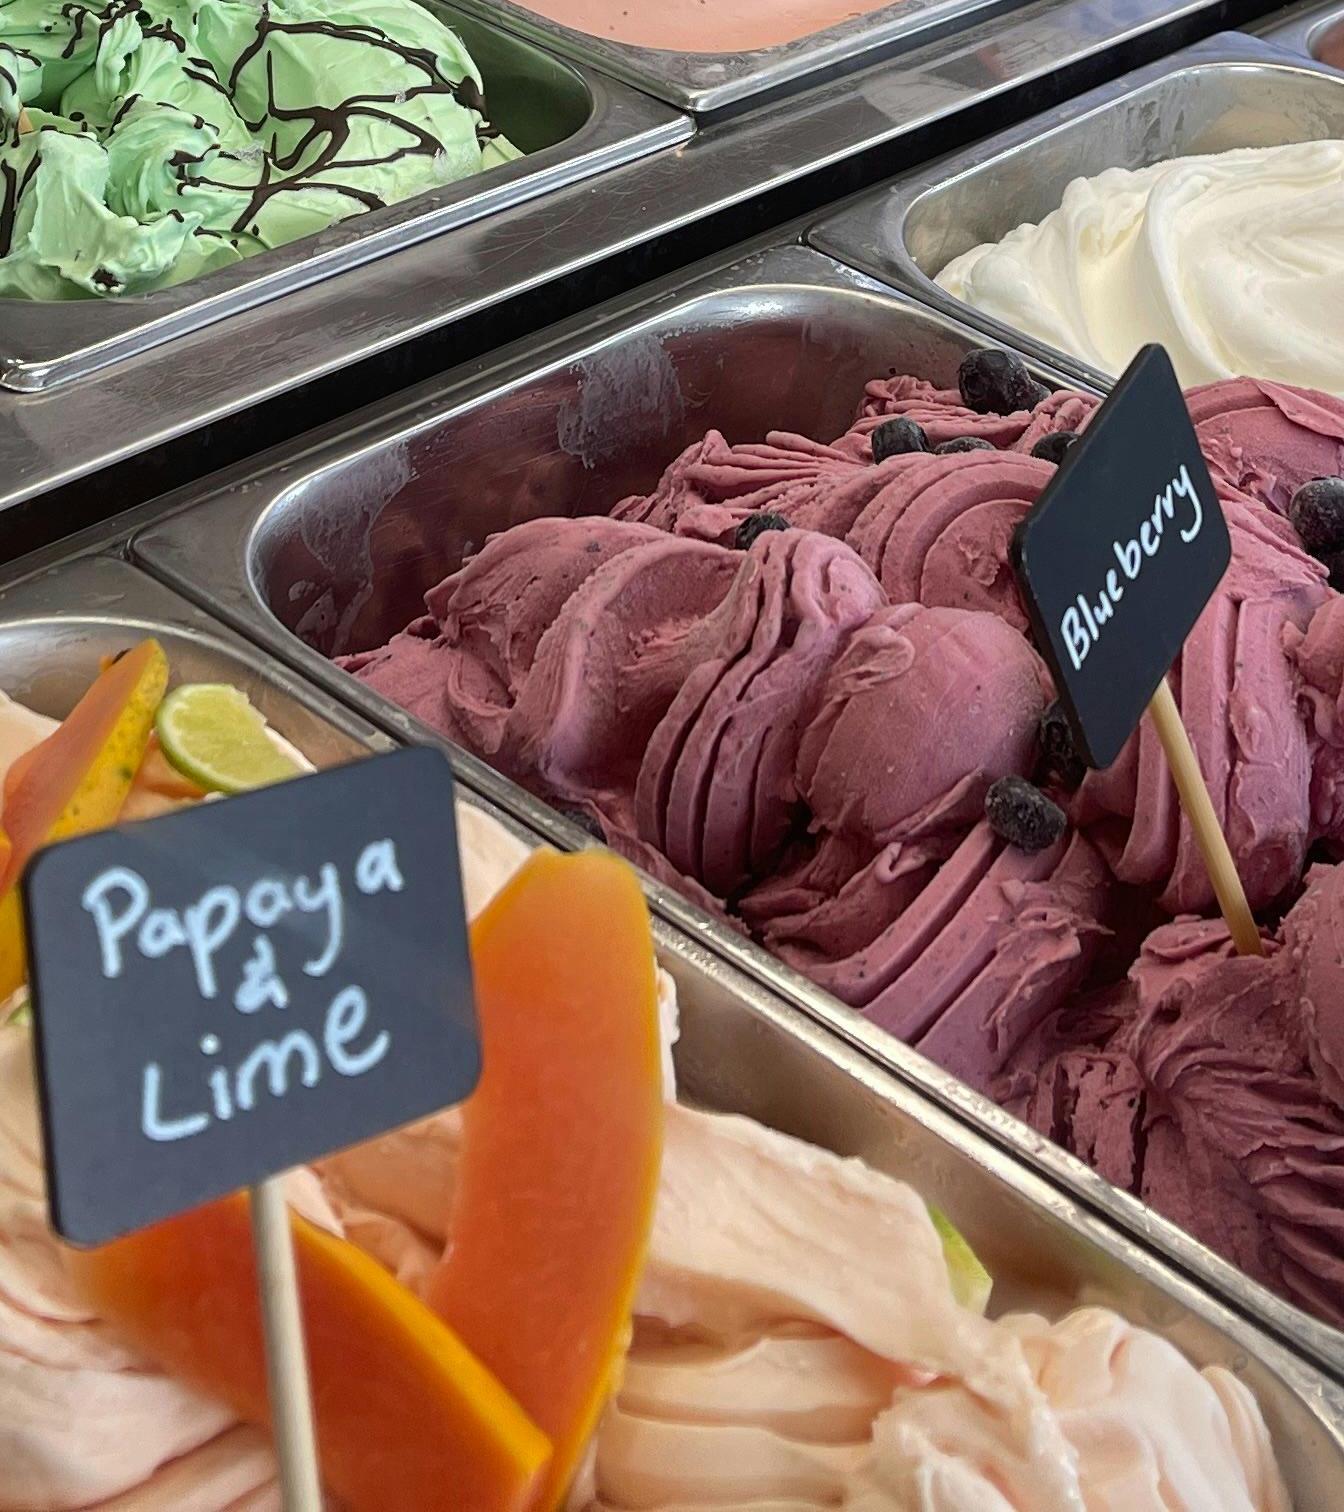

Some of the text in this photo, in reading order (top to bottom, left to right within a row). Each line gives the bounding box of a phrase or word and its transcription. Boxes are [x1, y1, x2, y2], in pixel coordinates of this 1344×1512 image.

[1061, 464, 1203, 671] Blueberry
[83, 838, 404, 998] Papaya
[142, 985, 391, 1142] Lime
